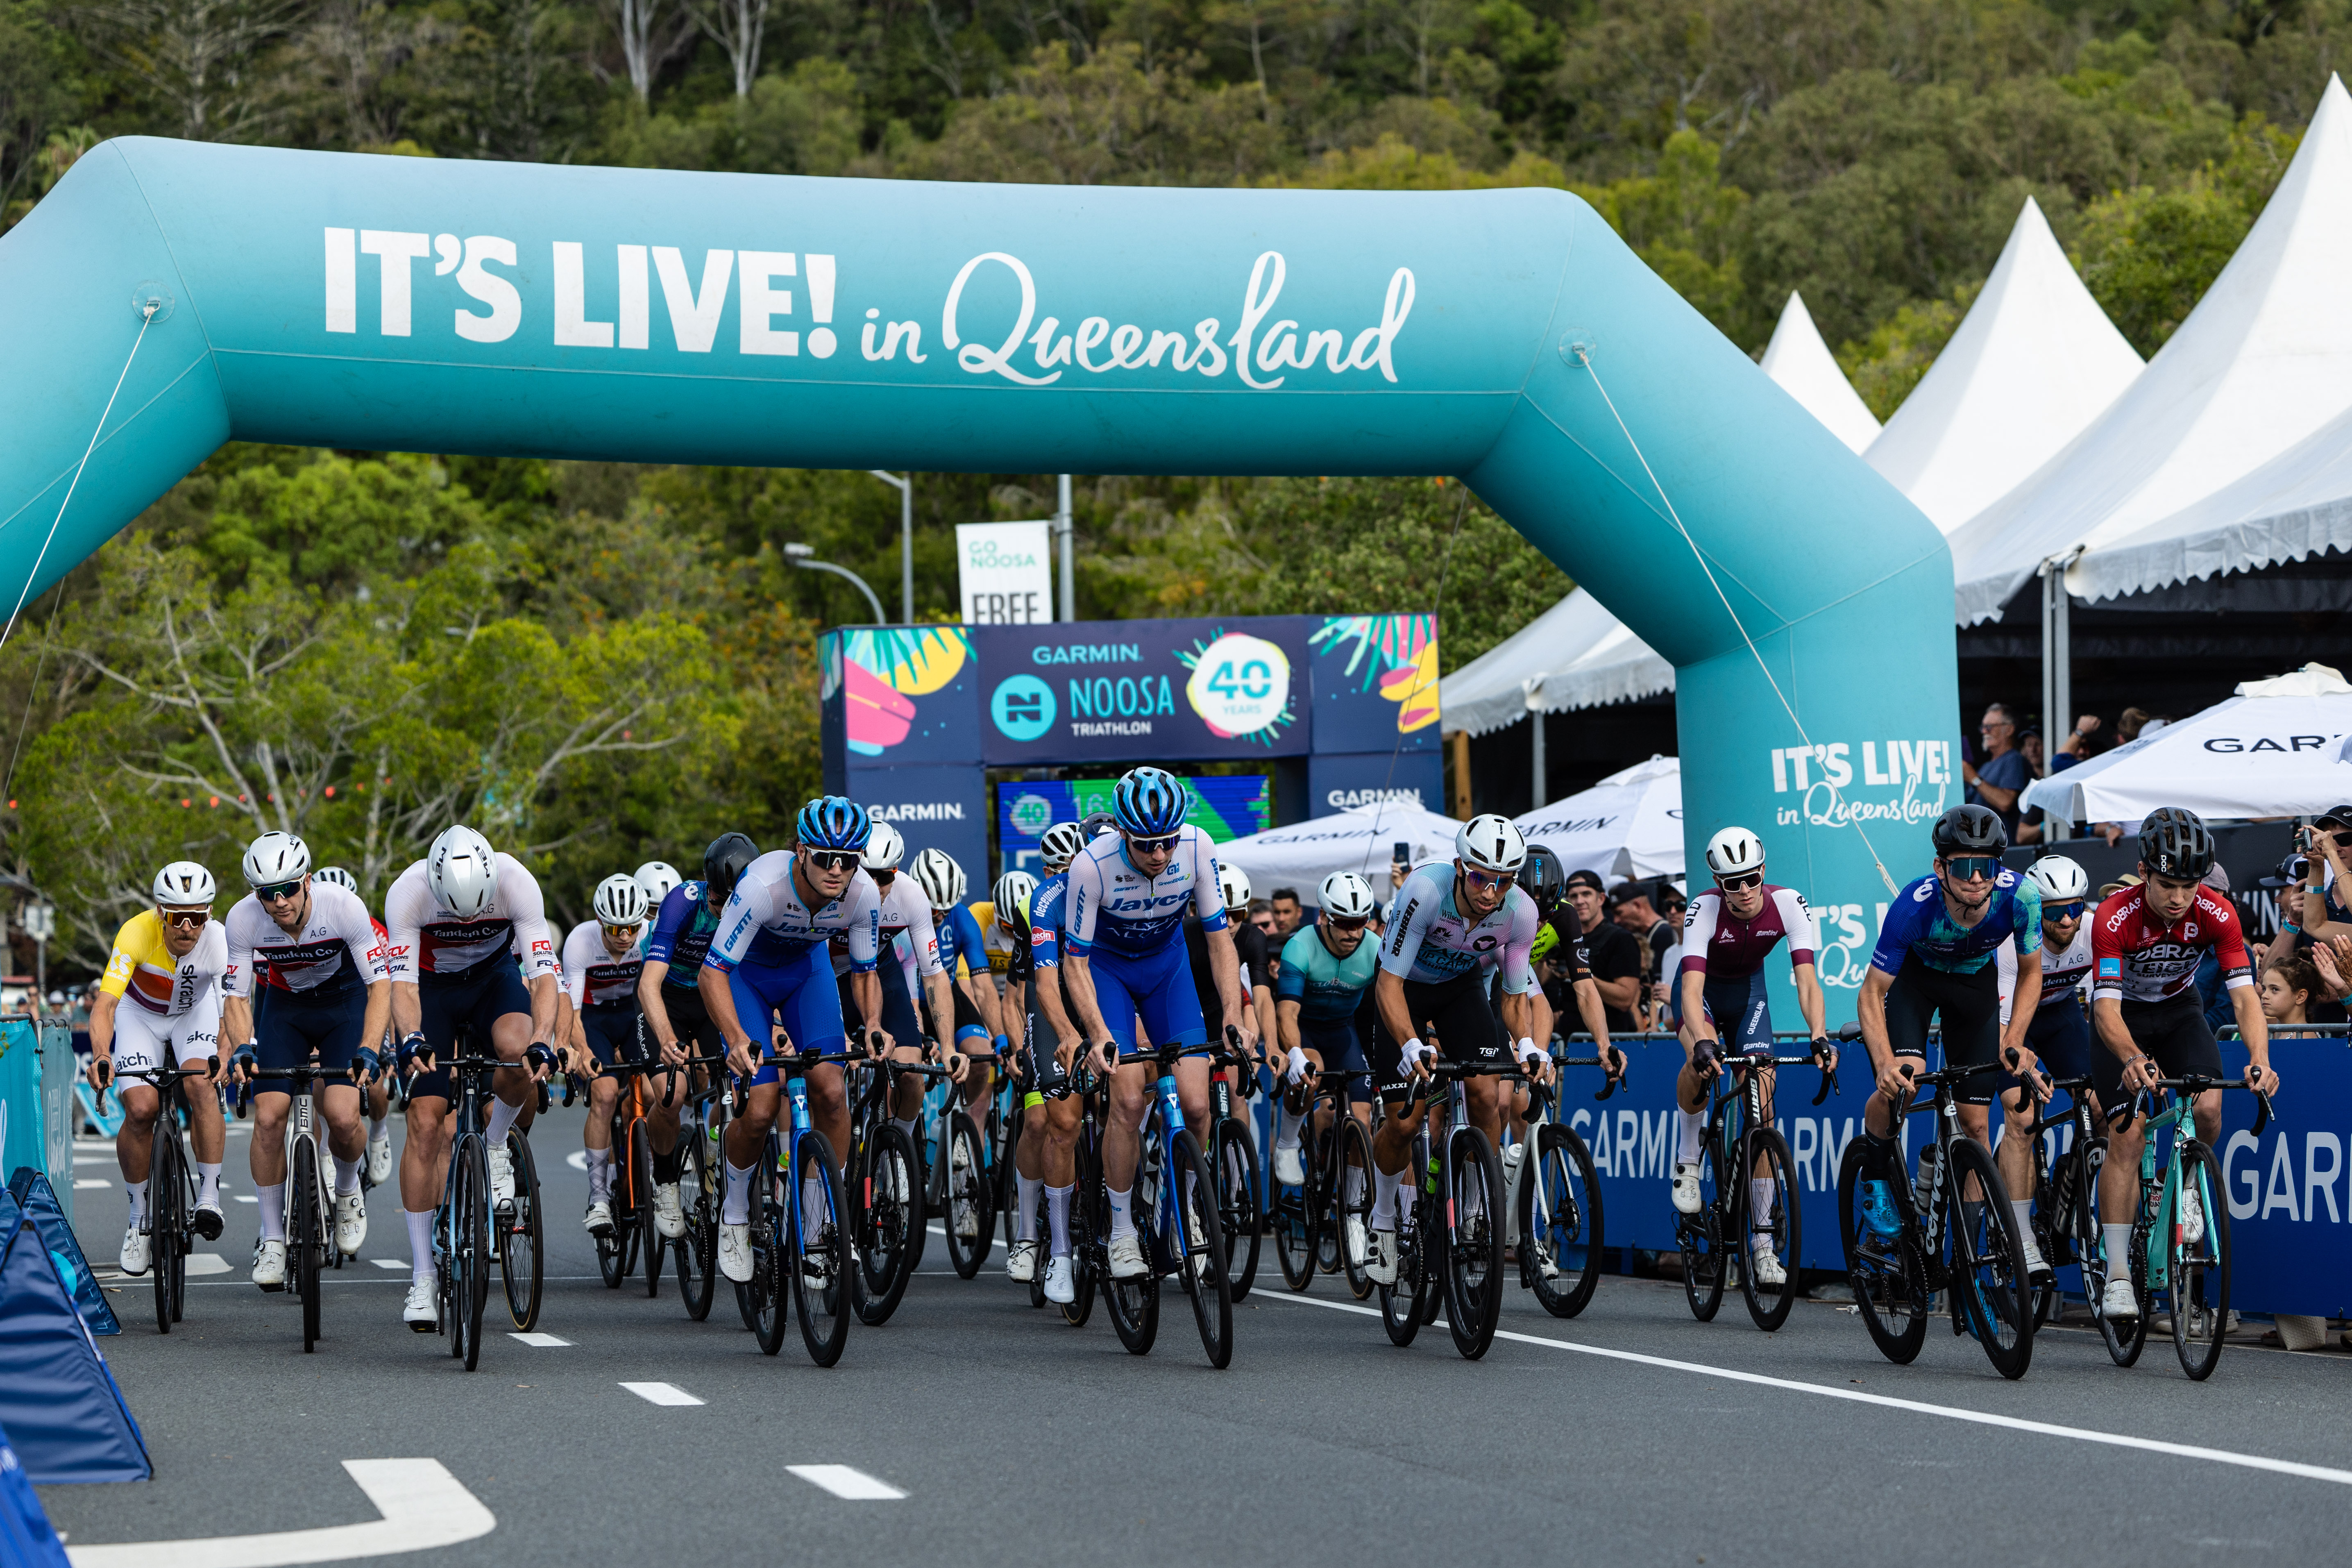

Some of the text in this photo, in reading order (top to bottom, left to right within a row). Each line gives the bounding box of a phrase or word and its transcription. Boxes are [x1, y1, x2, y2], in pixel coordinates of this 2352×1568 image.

[324, 227, 1416, 390] IT'S LIVE! in Queensland
[968, 540, 997, 554] GO
[971, 553, 1035, 569] NOOSA
[973, 592, 1039, 624] FREE
[1032, 643, 1142, 665] GARMIN
[1207, 660, 1271, 699] 40
[1069, 676, 1175, 719] NOOSA
[1222, 703, 1262, 716] YEARS
[1071, 721, 1152, 737] TRIATHLON
[2204, 734, 2342, 753] GAR
[1771, 740, 1951, 792] IT'S LIVE!
[867, 803, 963, 821] GARMIN
[1777, 775, 1946, 827] in Queensland
[435, 846, 447, 884] MET
[473, 844, 491, 878] MET
[1158, 876, 1185, 886] GreenEDGE
[1033, 879, 1066, 918] deceuninck
[1074, 884, 1086, 935] GIANT
[1100, 887, 1194, 912] Jayco
[882, 913, 898, 923] A.G
[1684, 901, 1701, 928] QLD
[310, 926, 327, 939] A.G
[433, 928, 480, 937] Tandem
[724, 908, 752, 953] GIANT
[768, 922, 842, 935] Jayco
[869, 909, 878, 950] GIANT
[1391, 897, 1420, 957] LIEBHERR
[264, 951, 314, 960] Tandem
[367, 946, 383, 961] FC
[628, 950, 639, 959] A.G
[1418, 949, 1434, 959] KIP
[2068, 954, 2084, 966] A.G
[227, 965, 239, 974] CV
[593, 969, 627, 977] Tandem
[177, 964, 198, 1010] skratch
[1747, 1001, 1766, 1035] QUEENSLAND
[186, 1030, 218, 1044] skra
[637, 1012, 650, 1060] BridgeLane
[1743, 1042, 1770, 1052] Santini
[1219, 1082, 1228, 1113] BMC
[1381, 1082, 1408, 1091] MAXXI
[1750, 1078, 1761, 1123] GIANT
[2107, 1102, 2129, 1117] GIAN
[299, 1098, 308, 1128] BMC
[2080, 1105, 2092, 1130] BMC
[2222, 1129, 2352, 1223] GAR
[1885, 1264, 1899, 1273] SHIMANO
